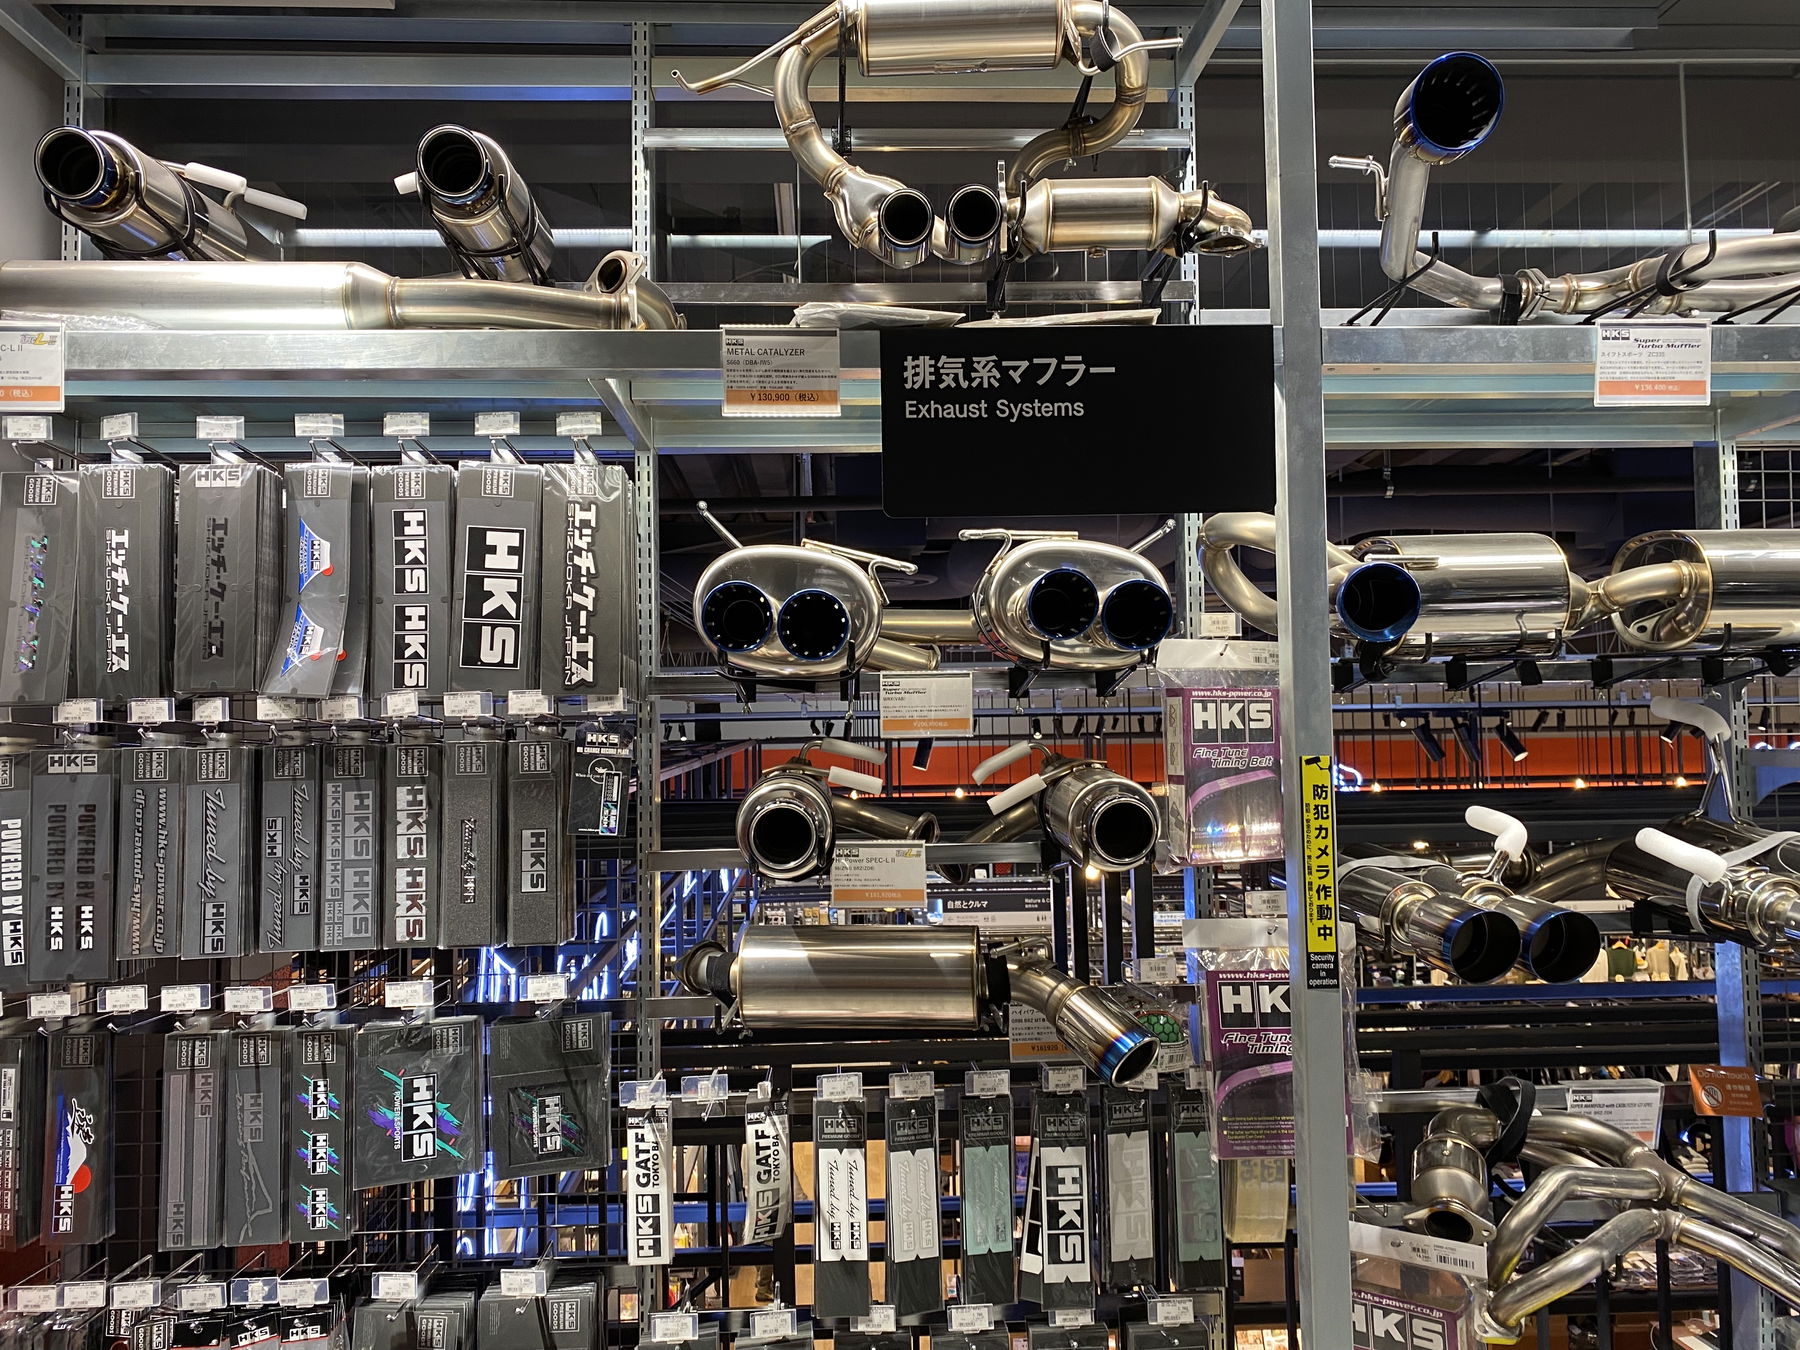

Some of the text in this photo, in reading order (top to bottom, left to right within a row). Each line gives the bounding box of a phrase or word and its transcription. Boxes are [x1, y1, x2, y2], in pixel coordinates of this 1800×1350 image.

[1602, 329, 1630, 339] HKS
[726, 348, 805, 356] METAL CATALYZER
[904, 354, 1117, 390] 排気系マフラー
[904, 399, 1085, 423] Exhaust Systems
[43, 478, 53, 502] HKS
[121, 470, 131, 496] HKS
[197, 469, 241, 483] HKS
[319, 469, 328, 494] HKS
[412, 472, 421, 496] HKS
[500, 470, 511, 495] HKS
[311, 540, 321, 571] HKS
[402, 511, 427, 593] HKS
[105, 529, 113, 615] SHIZUOKA
[479, 530, 521, 666] HKS
[564, 503, 575, 686] SHIZUOKA JAPAN
[403, 606, 427, 687] HKS
[1192, 689, 1272, 699] www.hks-power.co.jp
[1192, 702, 1273, 730] HKS
[587, 734, 619, 744] HKS
[1193, 748, 1248, 758] Fine Tune
[49, 755, 97, 769] HKS
[154, 752, 164, 778] HKS
[216, 753, 225, 778] HKS
[416, 750, 425, 774] HKS
[474, 747, 482, 772] HKS
[537, 744, 546, 771] HKS
[1211, 756, 1273, 769] Timing Belt
[330, 784, 341, 820] HKS
[352, 793, 370, 858] HKS
[403, 787, 427, 858] HKS
[289, 784, 310, 913] Tuned by HKS
[330, 822, 341, 859] HKS
[836, 849, 859, 857] HKS
[131, 788, 146, 955] www.hks-power.co.jp
[155, 787, 169, 954] www.hks-power.co.jp
[198, 787, 226, 953] Tuned by HKS
[527, 830, 547, 890] HKS
[1312, 783, 1333, 942] 防犯カメラ作動中
[1, 819, 25, 965] POWERED BY HKS
[46, 804, 67, 951] POWERED BY HKS
[76, 804, 97, 951] POWERED BY HKS
[266, 818, 287, 949] Tuned by HKS
[330, 861, 341, 898] HKS
[352, 870, 370, 936] HKS
[402, 869, 427, 940] HKS
[947, 900, 989, 909] 自然とクルマ
[1309, 953, 1335, 963] Security
[1311, 962, 1334, 970] camera
[1308, 977, 1338, 987] operation
[258, 1038, 266, 1063] HKS
[580, 1023, 589, 1048] HKS
[1223, 1032, 1256, 1043] Fine
[195, 1040, 206, 1066] HKS
[1697, 1070, 1710, 1078] Do
[198, 1074, 213, 1118] HKS
[313, 1080, 328, 1119] HKS
[1113, 1104, 1142, 1117] HKS
[247, 1093, 263, 1142] HKS
[412, 1078, 431, 1158] HKS
[540, 1095, 561, 1152] HKS
[824, 1119, 858, 1132] HKS
[896, 1120, 929, 1132] HKS
[971, 1117, 1003, 1129] HKS
[313, 1134, 328, 1173] HKS
[771, 1150, 781, 1184] TOKYO
[652, 1153, 660, 1188] TOKYO
[58, 1185, 73, 1233] HKS
[313, 1190, 328, 1229] HKS
[827, 1160, 842, 1250] Tuned by HKS
[846, 1160, 861, 1249] Tuned by HKS
[1124, 1152, 1147, 1240] HKS
[170, 1202, 184, 1248] HKS
[637, 1194, 657, 1257] HKS
[753, 1190, 774, 1242] HKS
[1057, 1167, 1083, 1262] HKS
[923, 1219, 933, 1247] HKS
[567, 1301, 576, 1330] HKS
[238, 1329, 269, 1345] HKS
[291, 1326, 320, 1338] HKS
[433, 1319, 443, 1349] HKS
